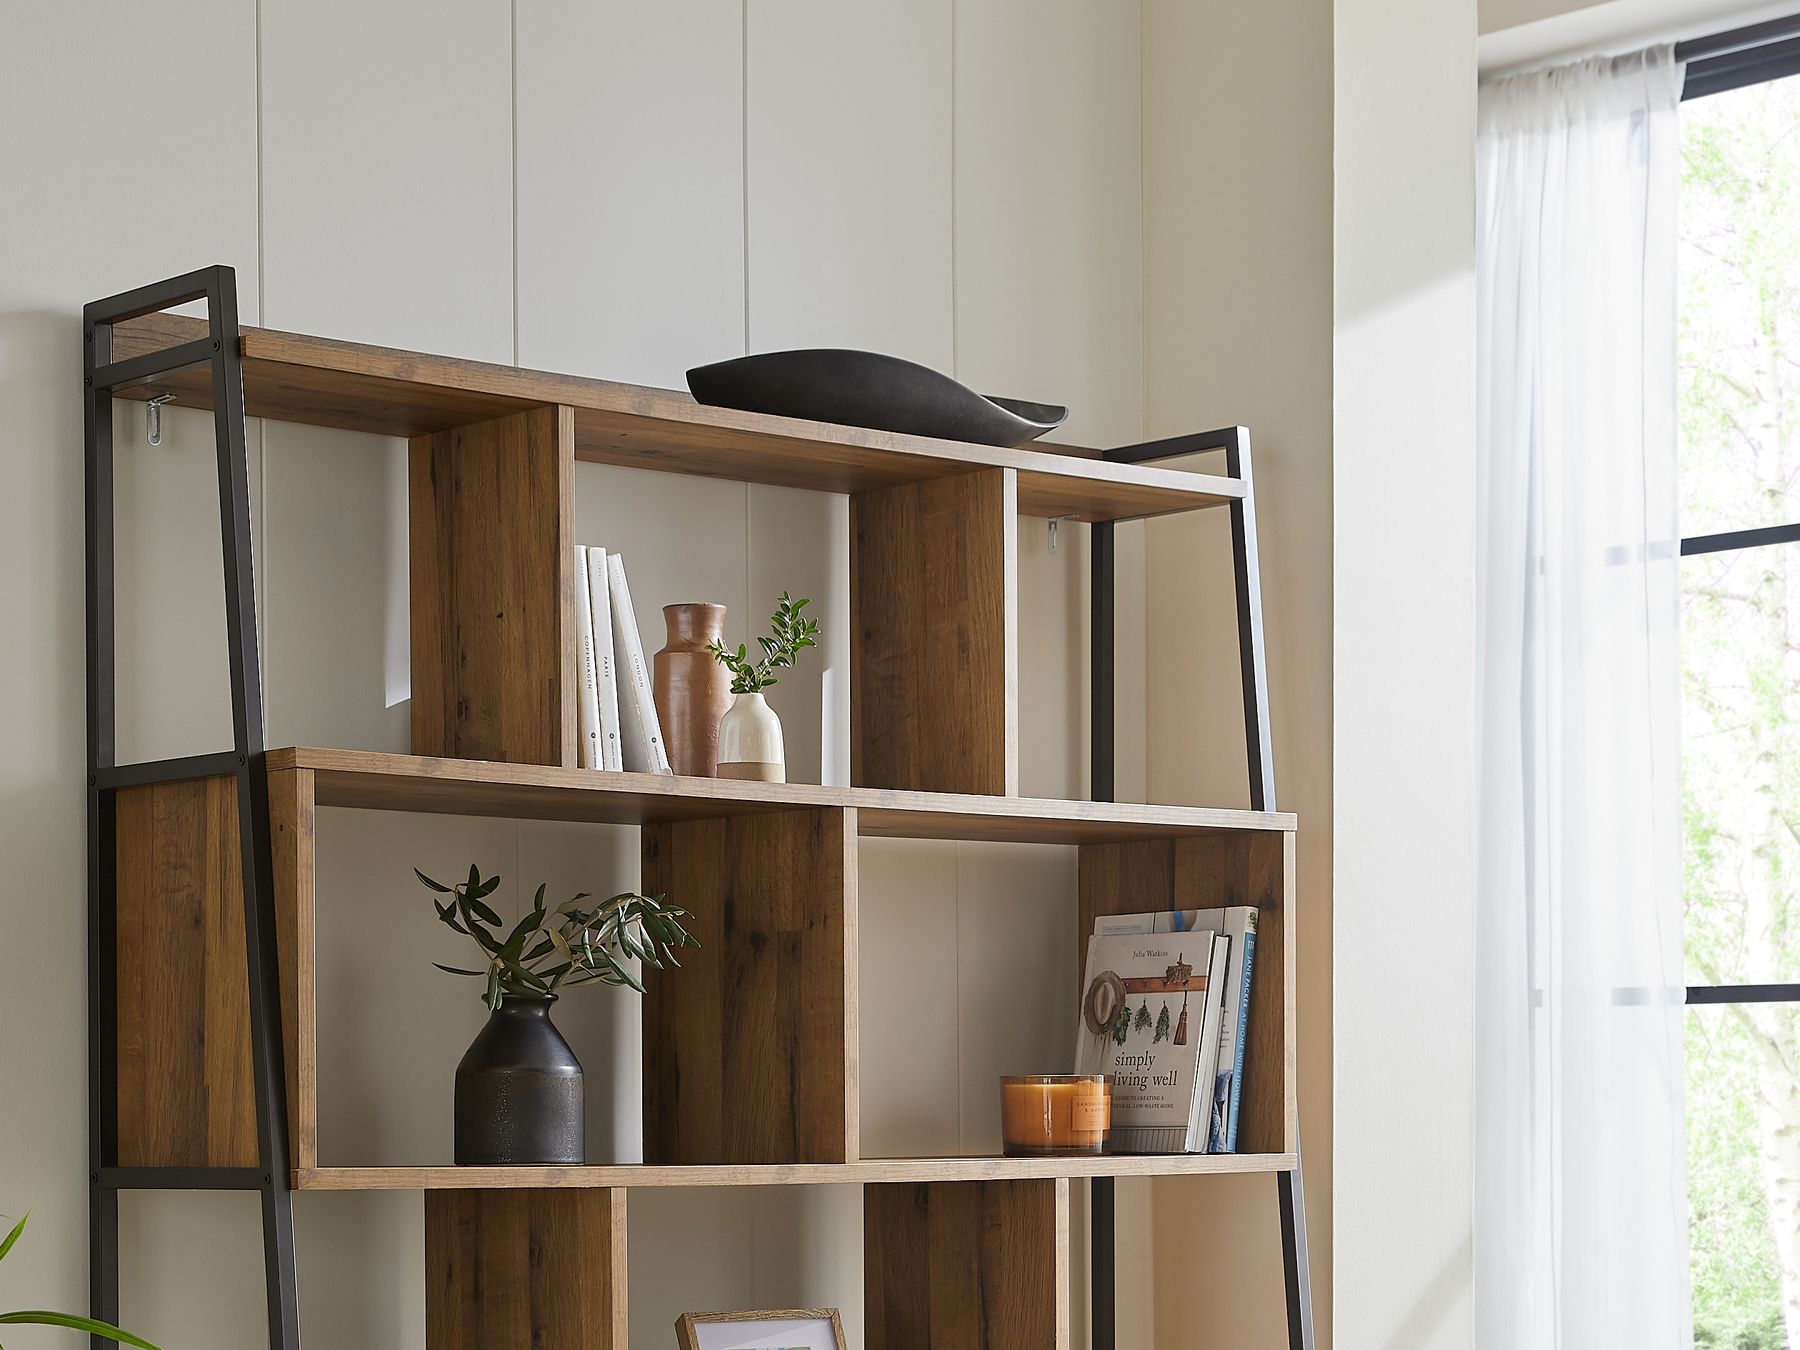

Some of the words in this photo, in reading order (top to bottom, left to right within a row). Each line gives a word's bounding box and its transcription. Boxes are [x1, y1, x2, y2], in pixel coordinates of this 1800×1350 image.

[584, 635, 592, 690] COPENHAGEN
[633, 653, 644, 688] LONDON
[1245, 955, 1253, 975] JANE
[1242, 978, 1251, 1008] PACKER
[1238, 1024, 1246, 1049] HOME
[1114, 1050, 1156, 1071] simply
[1236, 1052, 1244, 1073] WITH
[1113, 1070, 1148, 1091] living
[1152, 1070, 1178, 1086] well
[1232, 1075, 1241, 1111] FLOWERS
